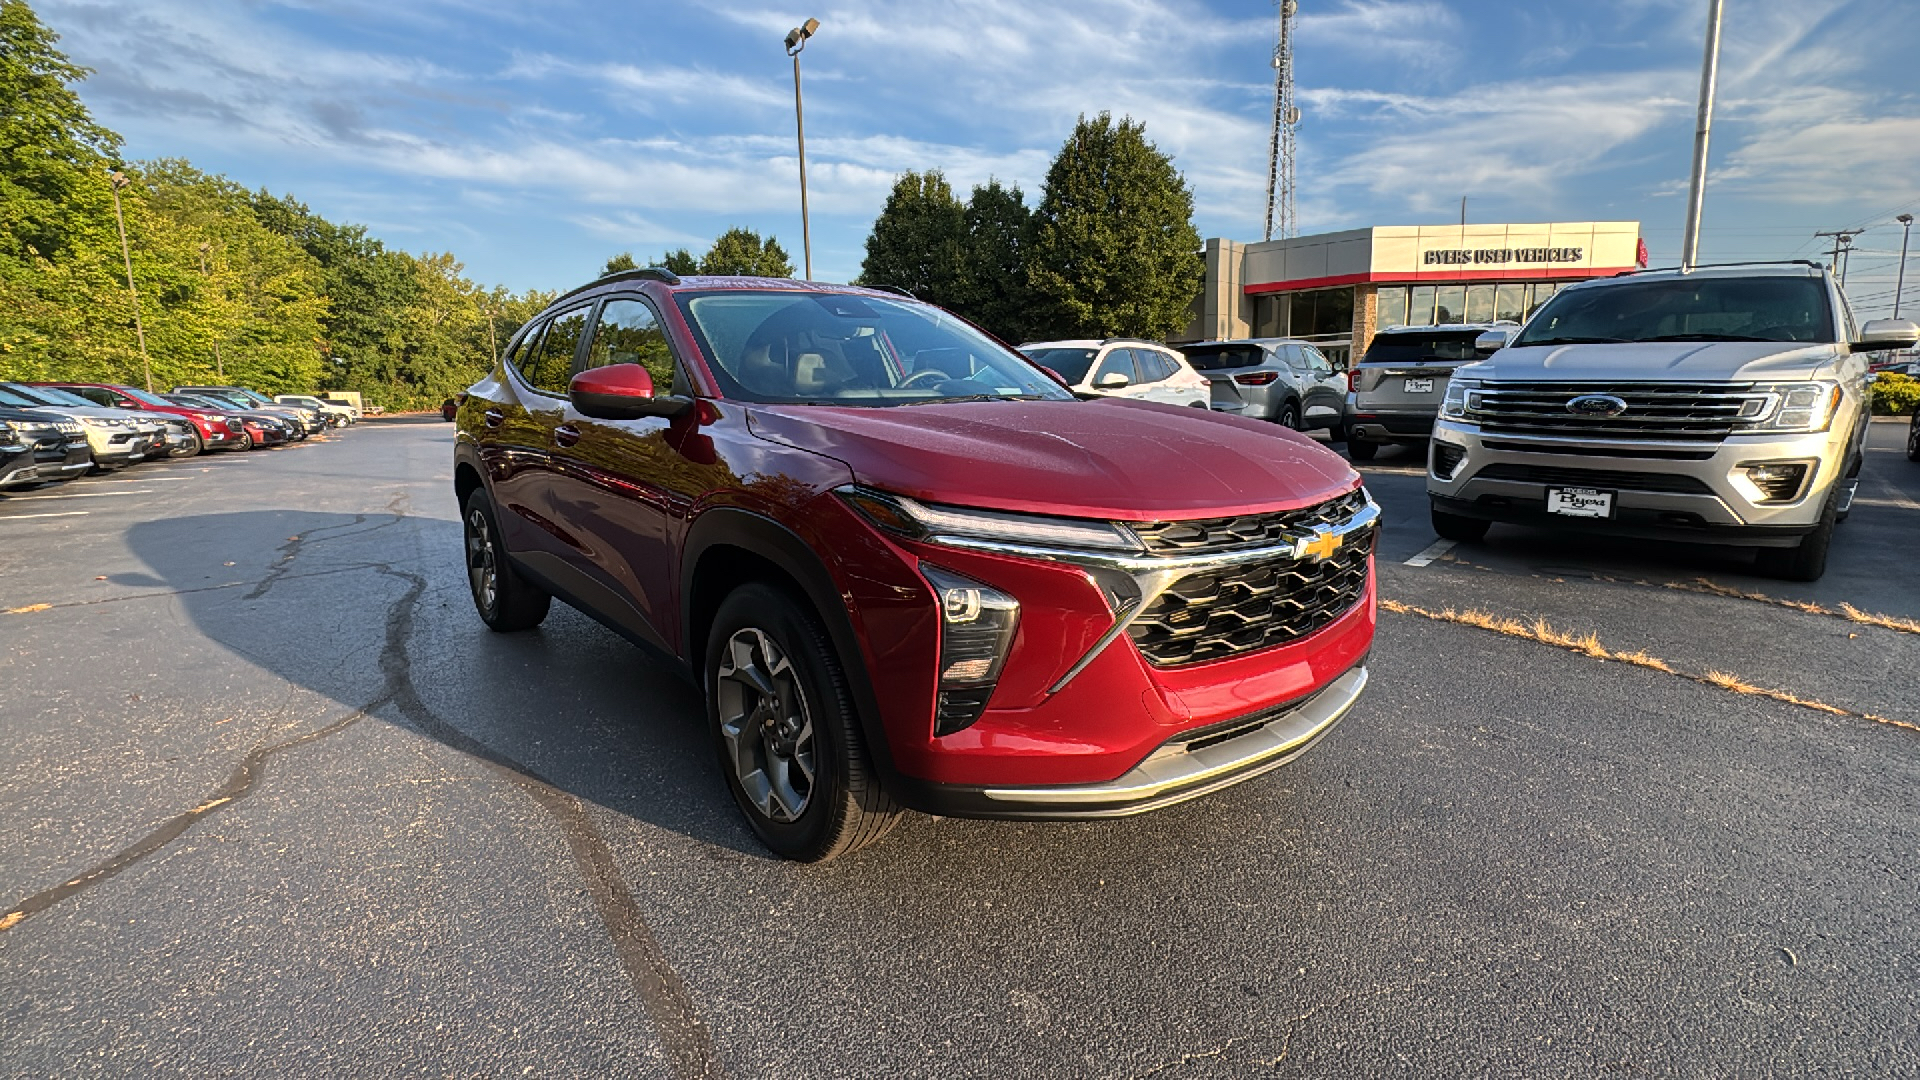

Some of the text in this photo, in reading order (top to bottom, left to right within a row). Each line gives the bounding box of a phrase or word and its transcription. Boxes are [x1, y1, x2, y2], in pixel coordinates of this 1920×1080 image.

[1424, 247, 1582, 265] BYERS USED VEHICLES
[1554, 491, 1605, 508] Byers
